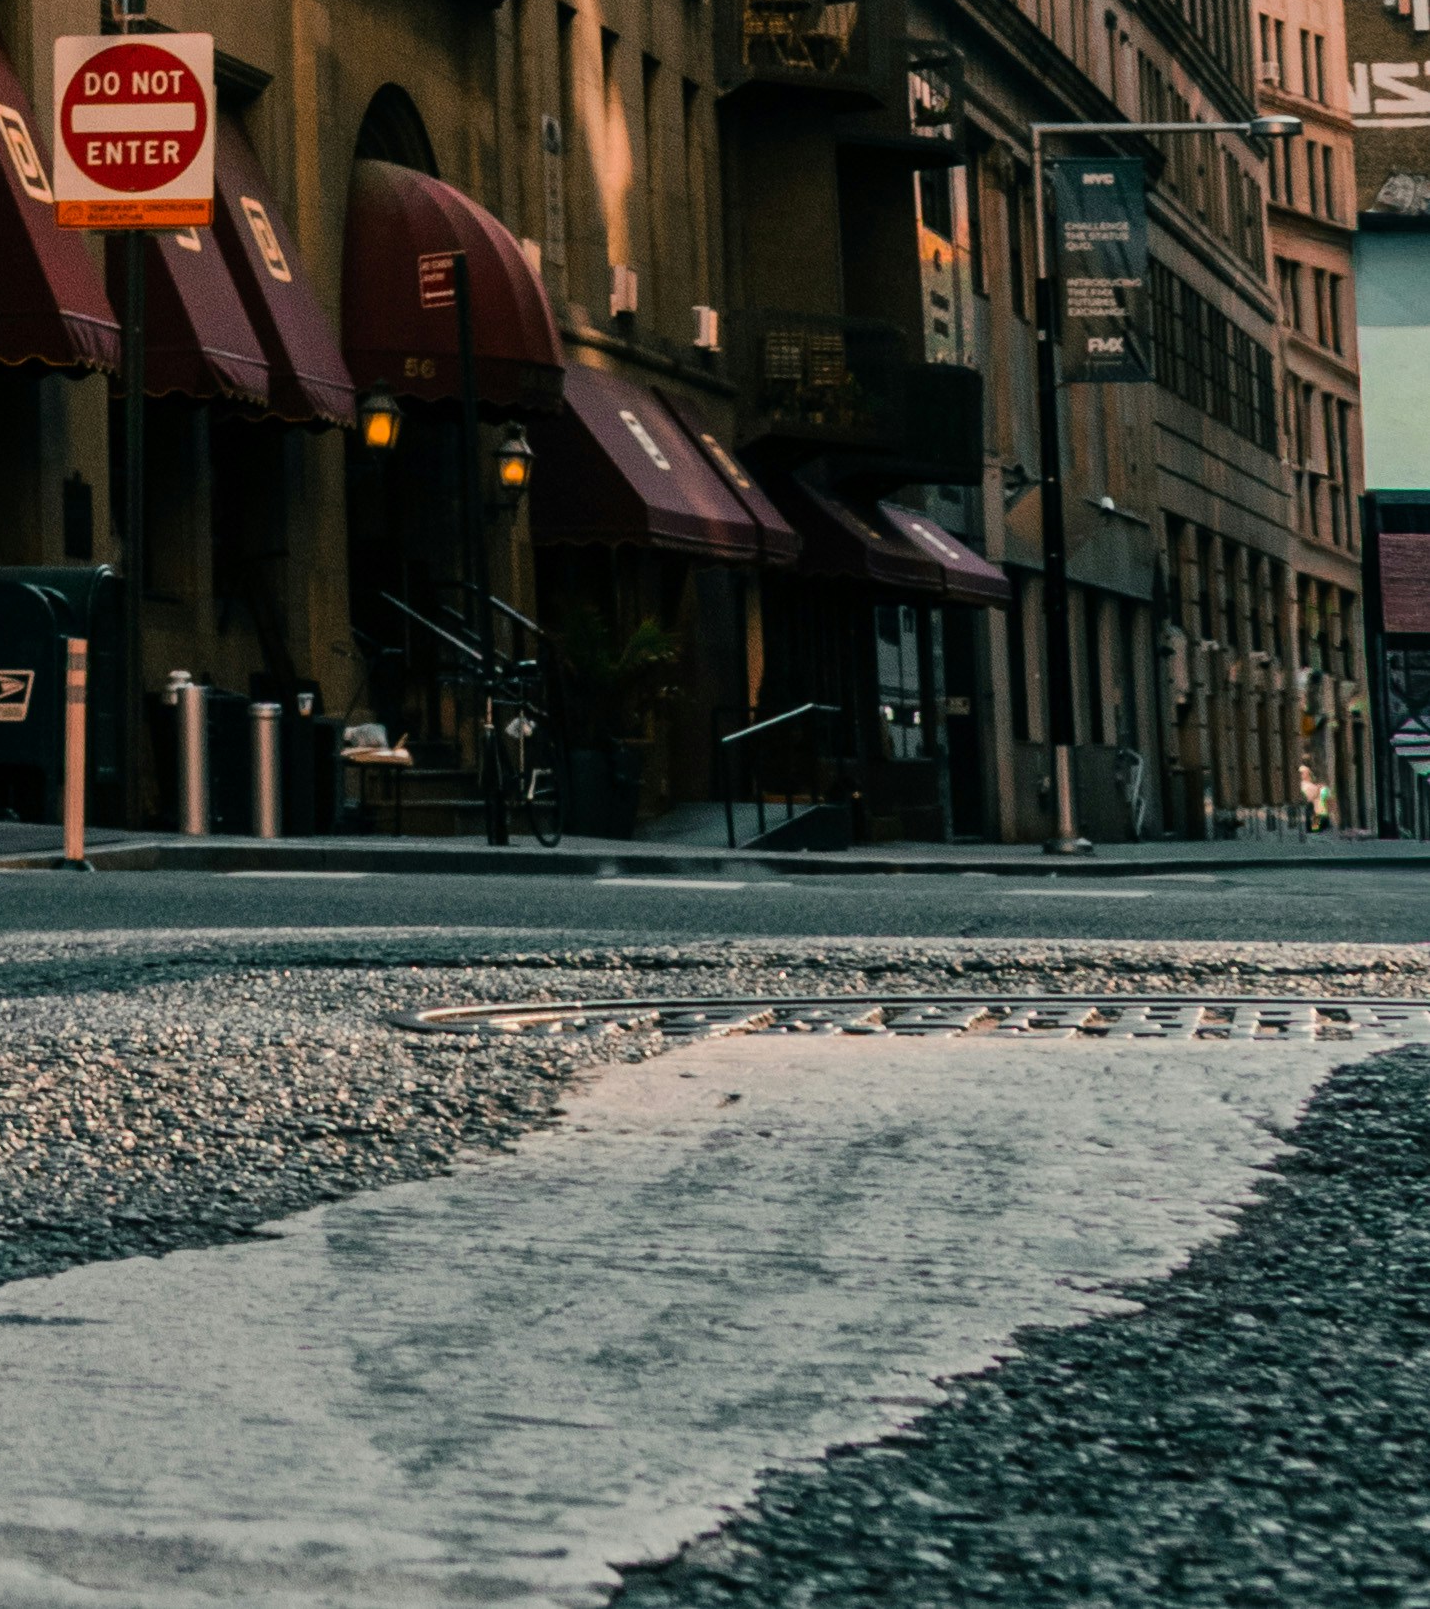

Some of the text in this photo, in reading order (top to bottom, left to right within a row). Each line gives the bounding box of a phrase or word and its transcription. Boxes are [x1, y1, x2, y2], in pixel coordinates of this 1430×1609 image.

[84, 70, 184, 96] DO NOT
[86, 140, 180, 165] ENTER
[1087, 337, 1124, 353] FMX
